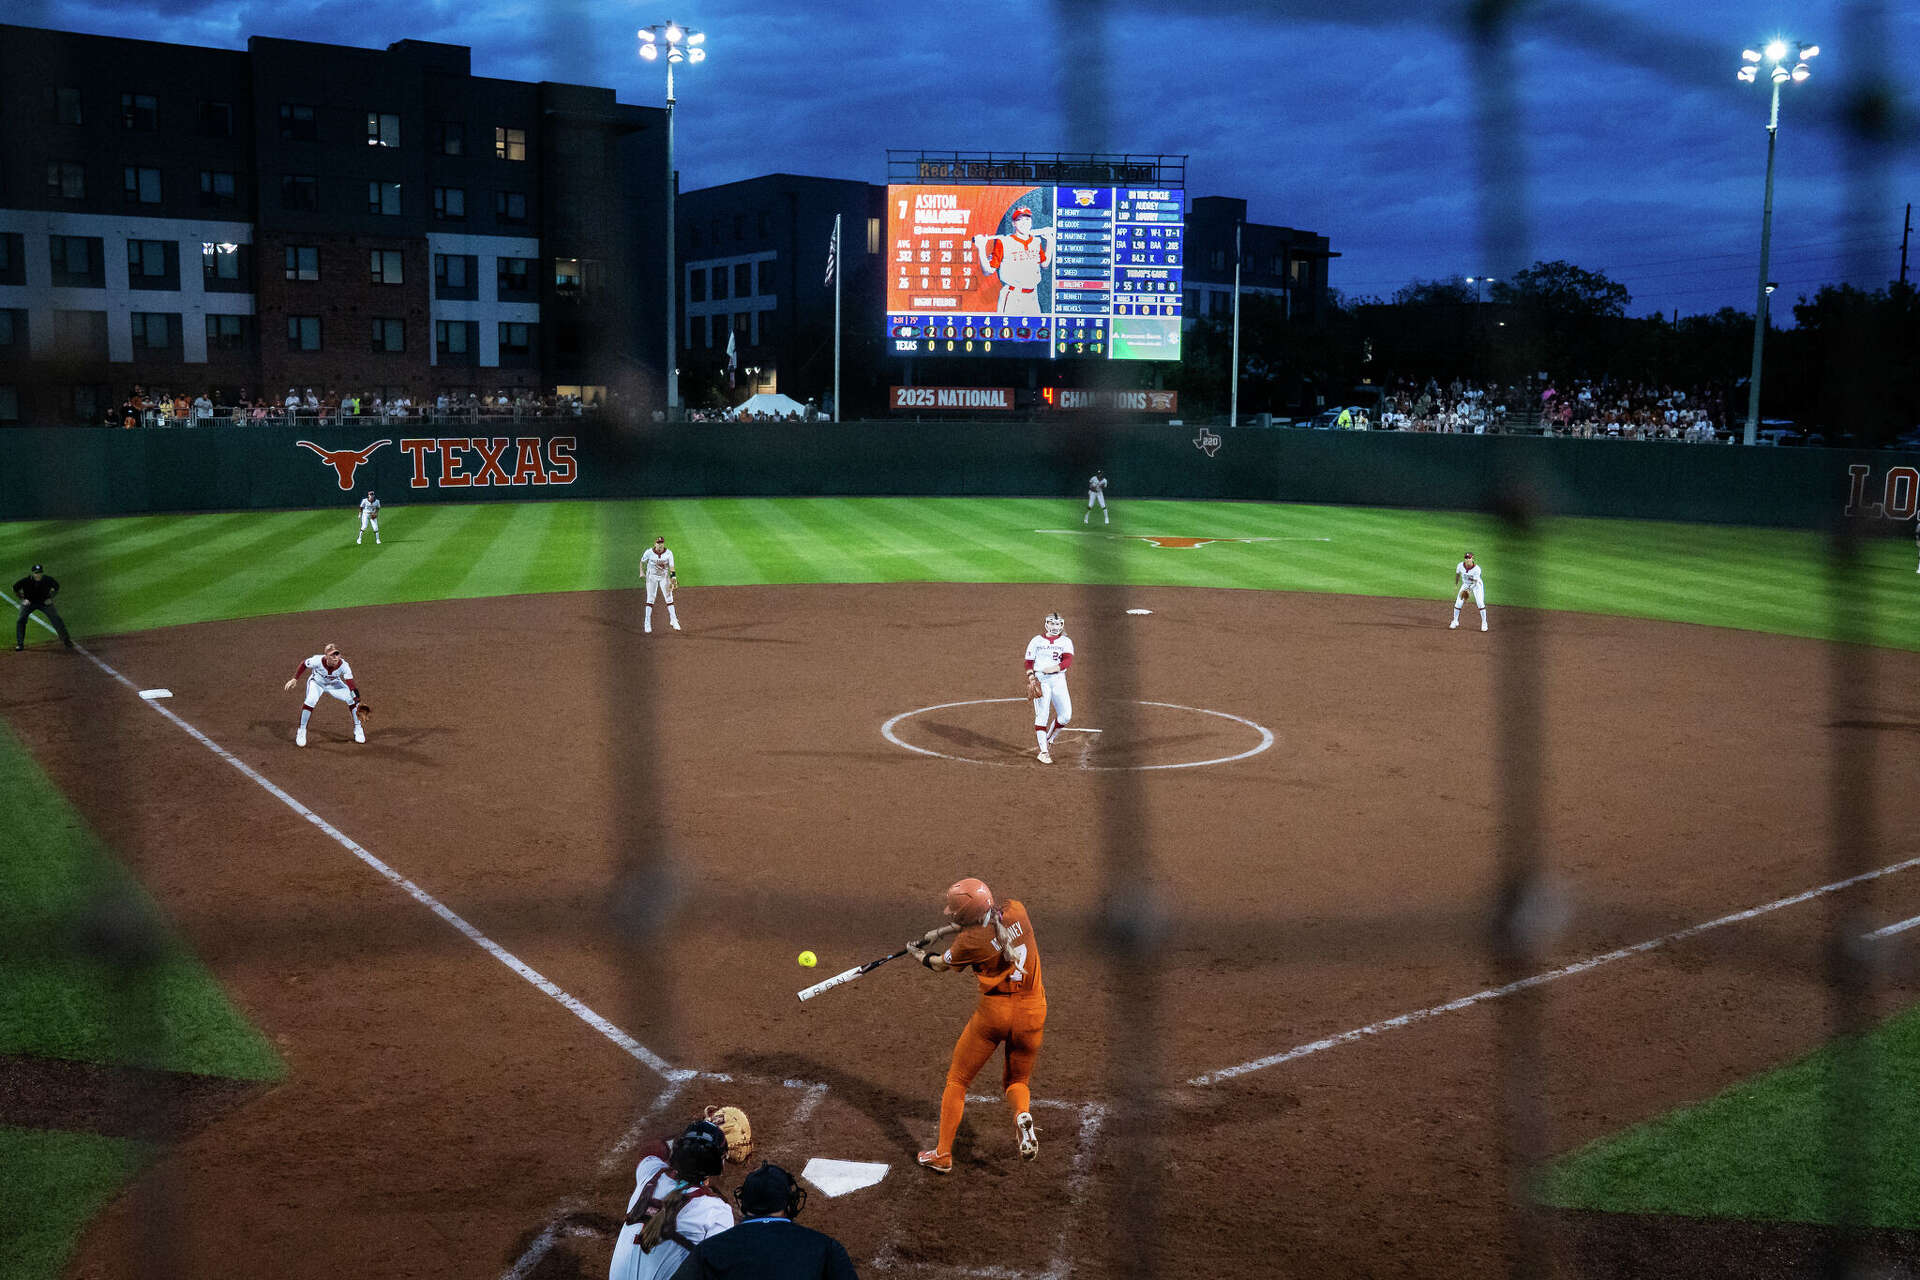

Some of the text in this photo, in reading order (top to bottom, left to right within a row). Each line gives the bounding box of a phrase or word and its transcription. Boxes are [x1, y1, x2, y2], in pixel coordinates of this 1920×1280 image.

[921, 162, 949, 177] Red
[915, 194, 957, 209] ASHTON
[1135, 201, 1159, 210] AUDREY
[898, 200, 908, 219] 7
[914, 209, 971, 224] MALONEY
[1135, 228, 1143, 237] 22
[897, 240, 911, 248] AVG
[921, 240, 930, 248] AB
[1149, 254, 1155, 262] K
[964, 278, 971, 289] 7
[1123, 282, 1133, 291] 55
[1136, 282, 1142, 290] K
[1147, 282, 1153, 291] 3
[1169, 282, 1175, 292] 0
[929, 317, 934, 326] 1
[947, 317, 953, 326] 2
[966, 317, 972, 326] 3
[983, 317, 991, 326] 4
[1002, 318, 1009, 326] 5
[1021, 318, 1028, 327] 6
[1041, 318, 1047, 327] 7
[1058, 318, 1067, 326] R
[1076, 318, 1085, 326] H
[1095, 319, 1104, 327] E
[929, 327, 935, 337] 2
[947, 327, 954, 338] 0
[966, 327, 973, 338] 0
[984, 328, 991, 338] 0
[1003, 328, 1009, 338] 0
[1060, 328, 1066, 339] 2
[1077, 329, 1083, 339] 4
[1096, 329, 1103, 339] 0
[895, 340, 1102, 354] TEXAS 0 0 0 0 0 3 1
[897, 388, 1008, 407] 2025 NATIONAL
[1043, 387, 1054, 405] 4
[1203, 437, 1218, 446] 220
[400, 436, 578, 488] TEXAS
[1010, 943, 1028, 981] 7
